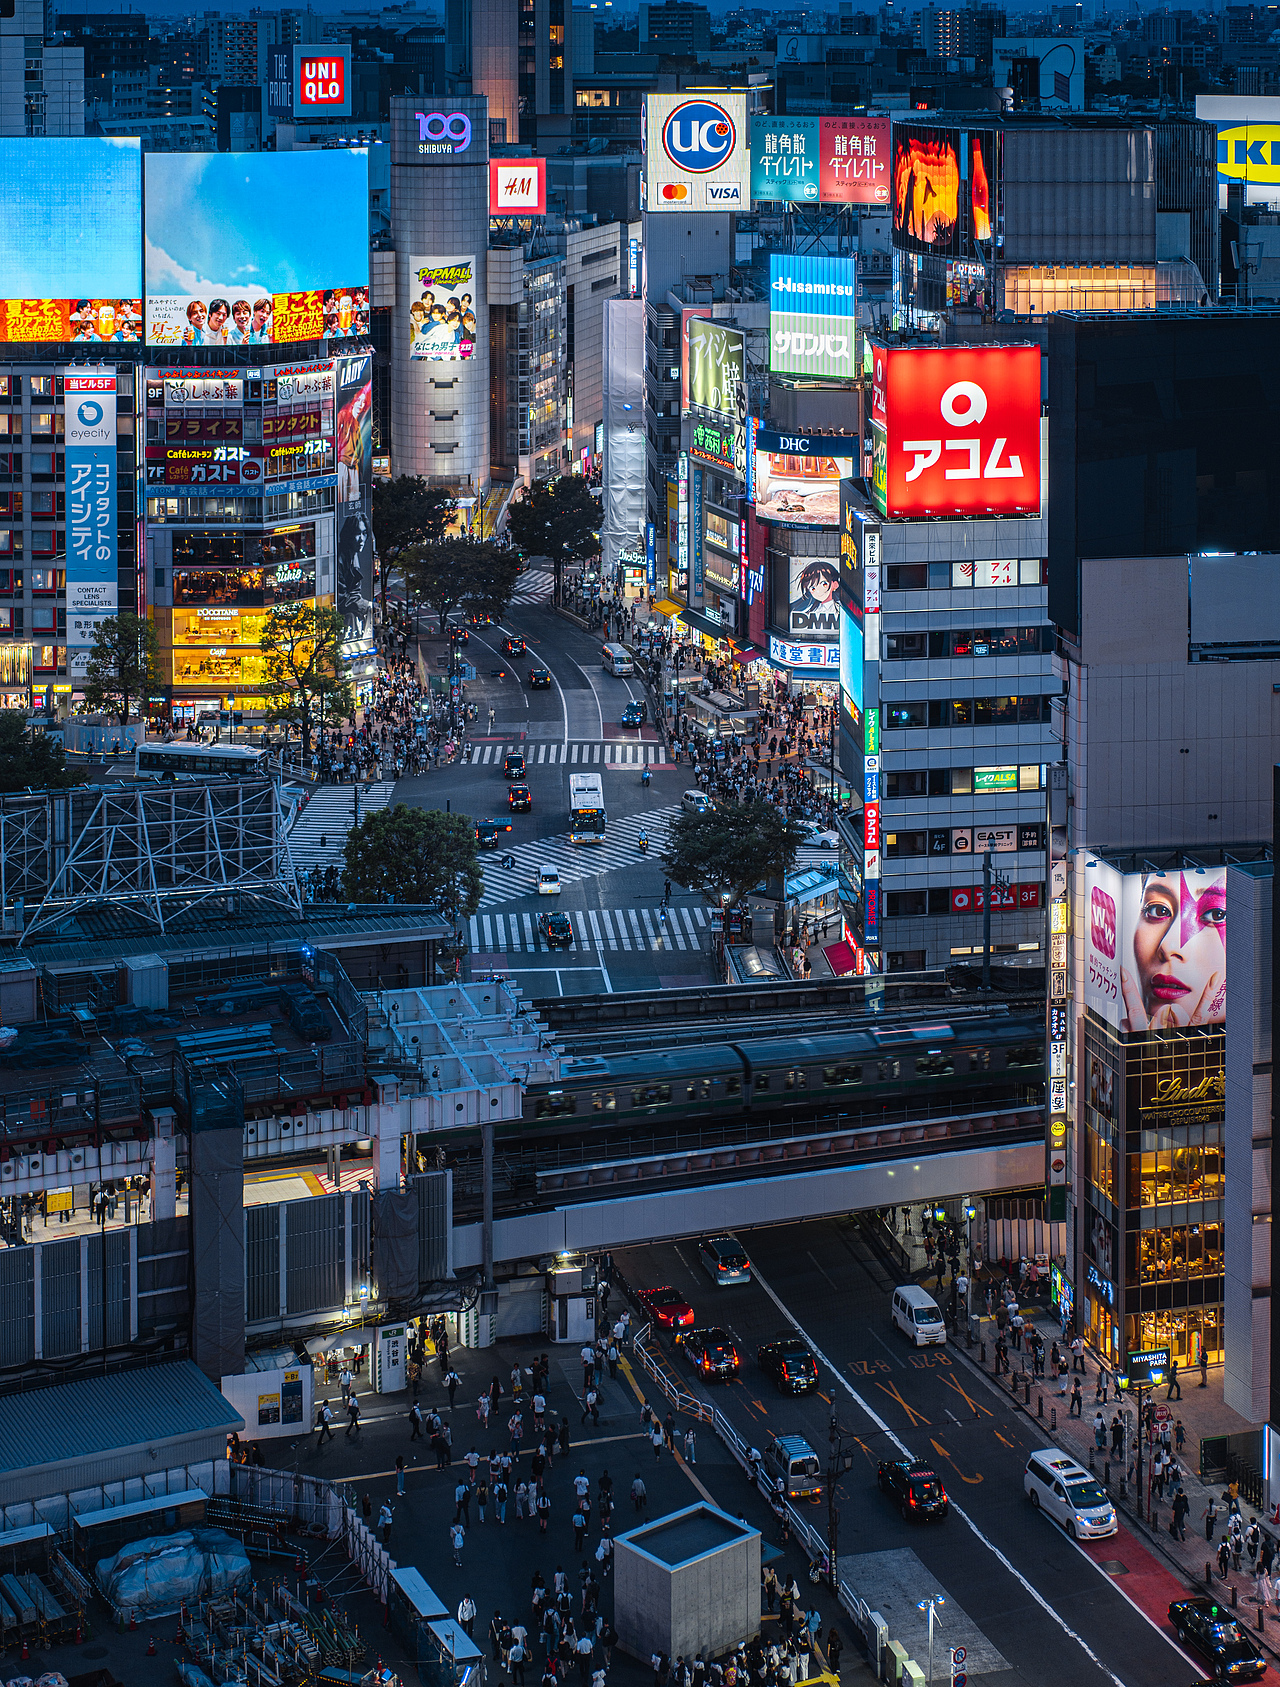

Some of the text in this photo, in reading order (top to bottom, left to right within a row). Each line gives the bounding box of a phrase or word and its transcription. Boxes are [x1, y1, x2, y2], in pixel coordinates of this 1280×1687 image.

[273, 54, 288, 79] THE
[305, 62, 337, 80] UNI
[269, 82, 292, 107] PRIME
[305, 82, 340, 102] QLO
[415, 112, 472, 153] 109
[418, 144, 452, 154] SHIBUYA
[765, 133, 806, 155] 龍角散
[834, 134, 877, 156] 龍角散
[759, 156, 814, 177] ダイレクト
[828, 158, 885, 179] ダイレクト
[504, 177, 532, 196] H&M
[709, 187, 740, 199] VISA
[772, 277, 853, 296] Hisamitsu
[5, 299, 62, 318] 夏こそ、
[272, 290, 323, 316] 夏こそ、
[414, 341, 457, 351] なにわ男子
[774, 331, 850, 359] サロンパス
[158, 368, 240, 379] しゃぶしゃぶバイキング
[341, 357, 368, 387] LADY
[69, 378, 112, 389] 当ビル5F
[192, 384, 239, 399] しゃぶ葉
[296, 375, 332, 395] しゃぶ葉
[148, 388, 163, 398] 9F
[873, 384, 886, 413] アコム
[167, 420, 240, 435] プライス
[263, 414, 319, 435] コンタクト
[71, 427, 111, 440] eyecity
[304, 438, 332, 455] ガスト
[780, 437, 810, 452] DHC
[213, 446, 252, 462] ガスト
[903, 437, 1024, 482] アコム
[148, 466, 166, 477] 7F
[169, 465, 189, 474] Café
[191, 463, 236, 482] ガスト
[179, 486, 244, 496] 英会話イーオン
[268, 485, 285, 493] AEON
[288, 476, 337, 492] 英会話イーオン
[71, 464, 92, 561] アイシティ
[96, 464, 111, 561] コンタクトの
[990, 561, 1012, 572] アイ
[276, 568, 303, 583] Ushi8
[990, 575, 1012, 584] フル
[209, 648, 227, 657] Café
[772, 642, 840, 664] 大盛堂書店
[975, 772, 1016, 784] レイクALSA
[867, 819, 877, 844] アコム
[976, 830, 1014, 841] EAST
[933, 840, 946, 851] 4F
[1021, 891, 1036, 902] 3F
[868, 889, 876, 926] PROMISE
[1089, 965, 1118, 1000] ワクワク
[1051, 1008, 1059, 1035] カラオケ
[1052, 1044, 1065, 1054] 3F
[1150, 1077, 1215, 1104] Lindt
[1170, 1116, 1195, 1126] DEPUIS
[391, 1340, 399, 1366] 渋谷駅
[908, 1352, 953, 1369] 8-20
[1132, 1353, 1167, 1364] MIYASHITA
[847, 1360, 893, 1376] 8-20
